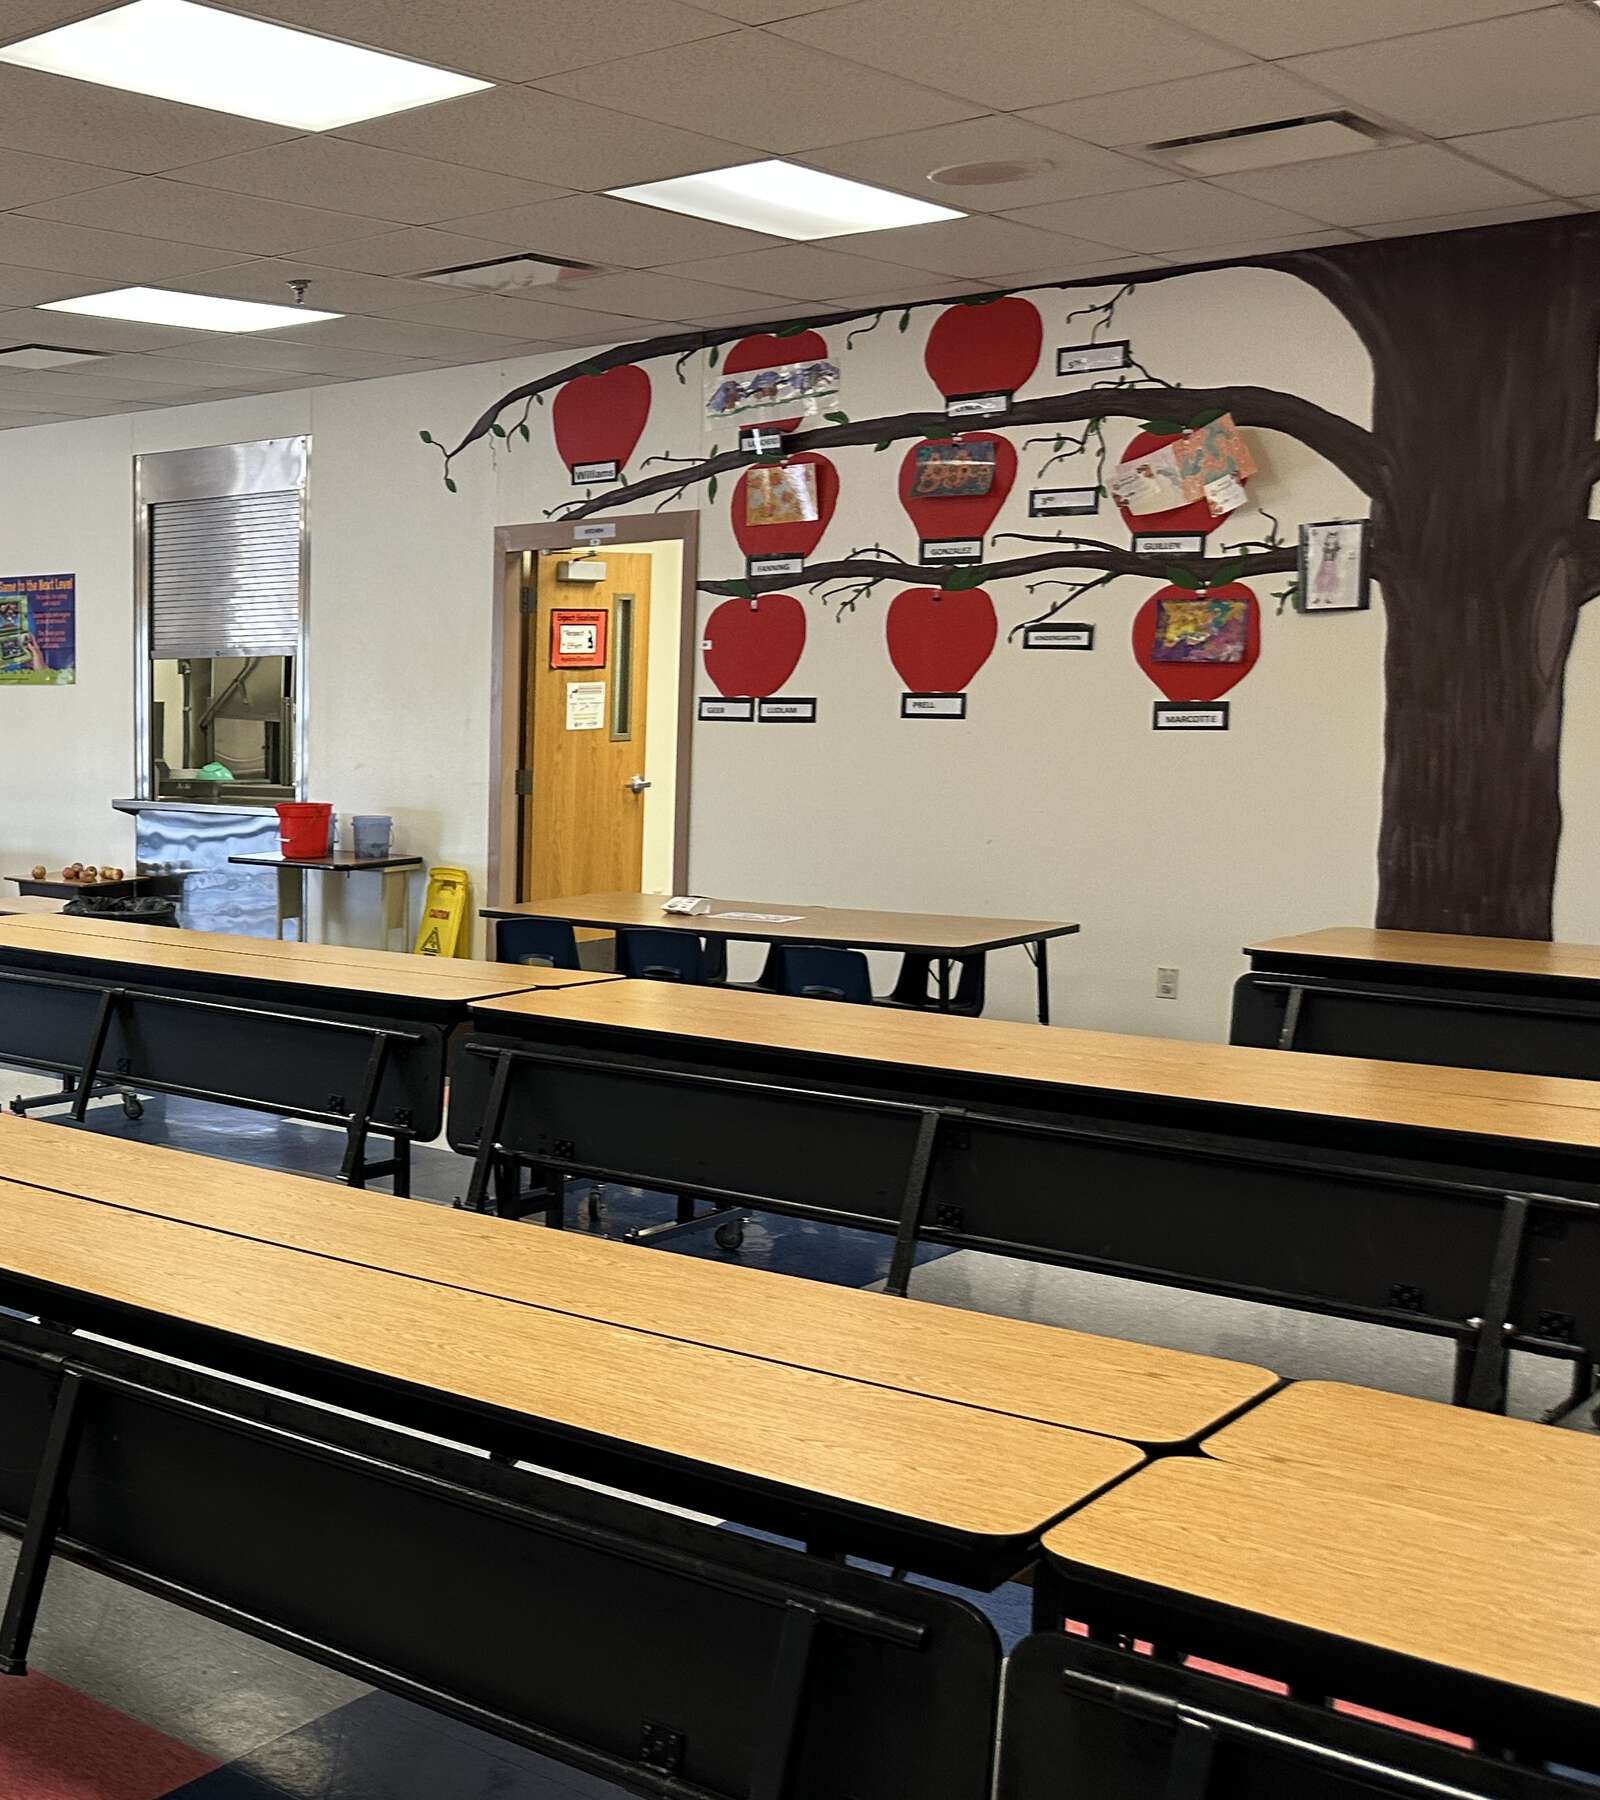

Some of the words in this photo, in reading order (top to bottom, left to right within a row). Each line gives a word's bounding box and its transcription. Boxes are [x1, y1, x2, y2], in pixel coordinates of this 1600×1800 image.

[575, 469, 614, 480] Williams
[930, 546, 973, 555] GONZALEZ
[17, 581, 26, 591] to
[26, 580, 38, 591] the
[38, 579, 54, 590] Next
[54, 578, 73, 590] Level
[912, 701, 937, 709] PRELL
[1165, 715, 1217, 723] MARCOTTE
